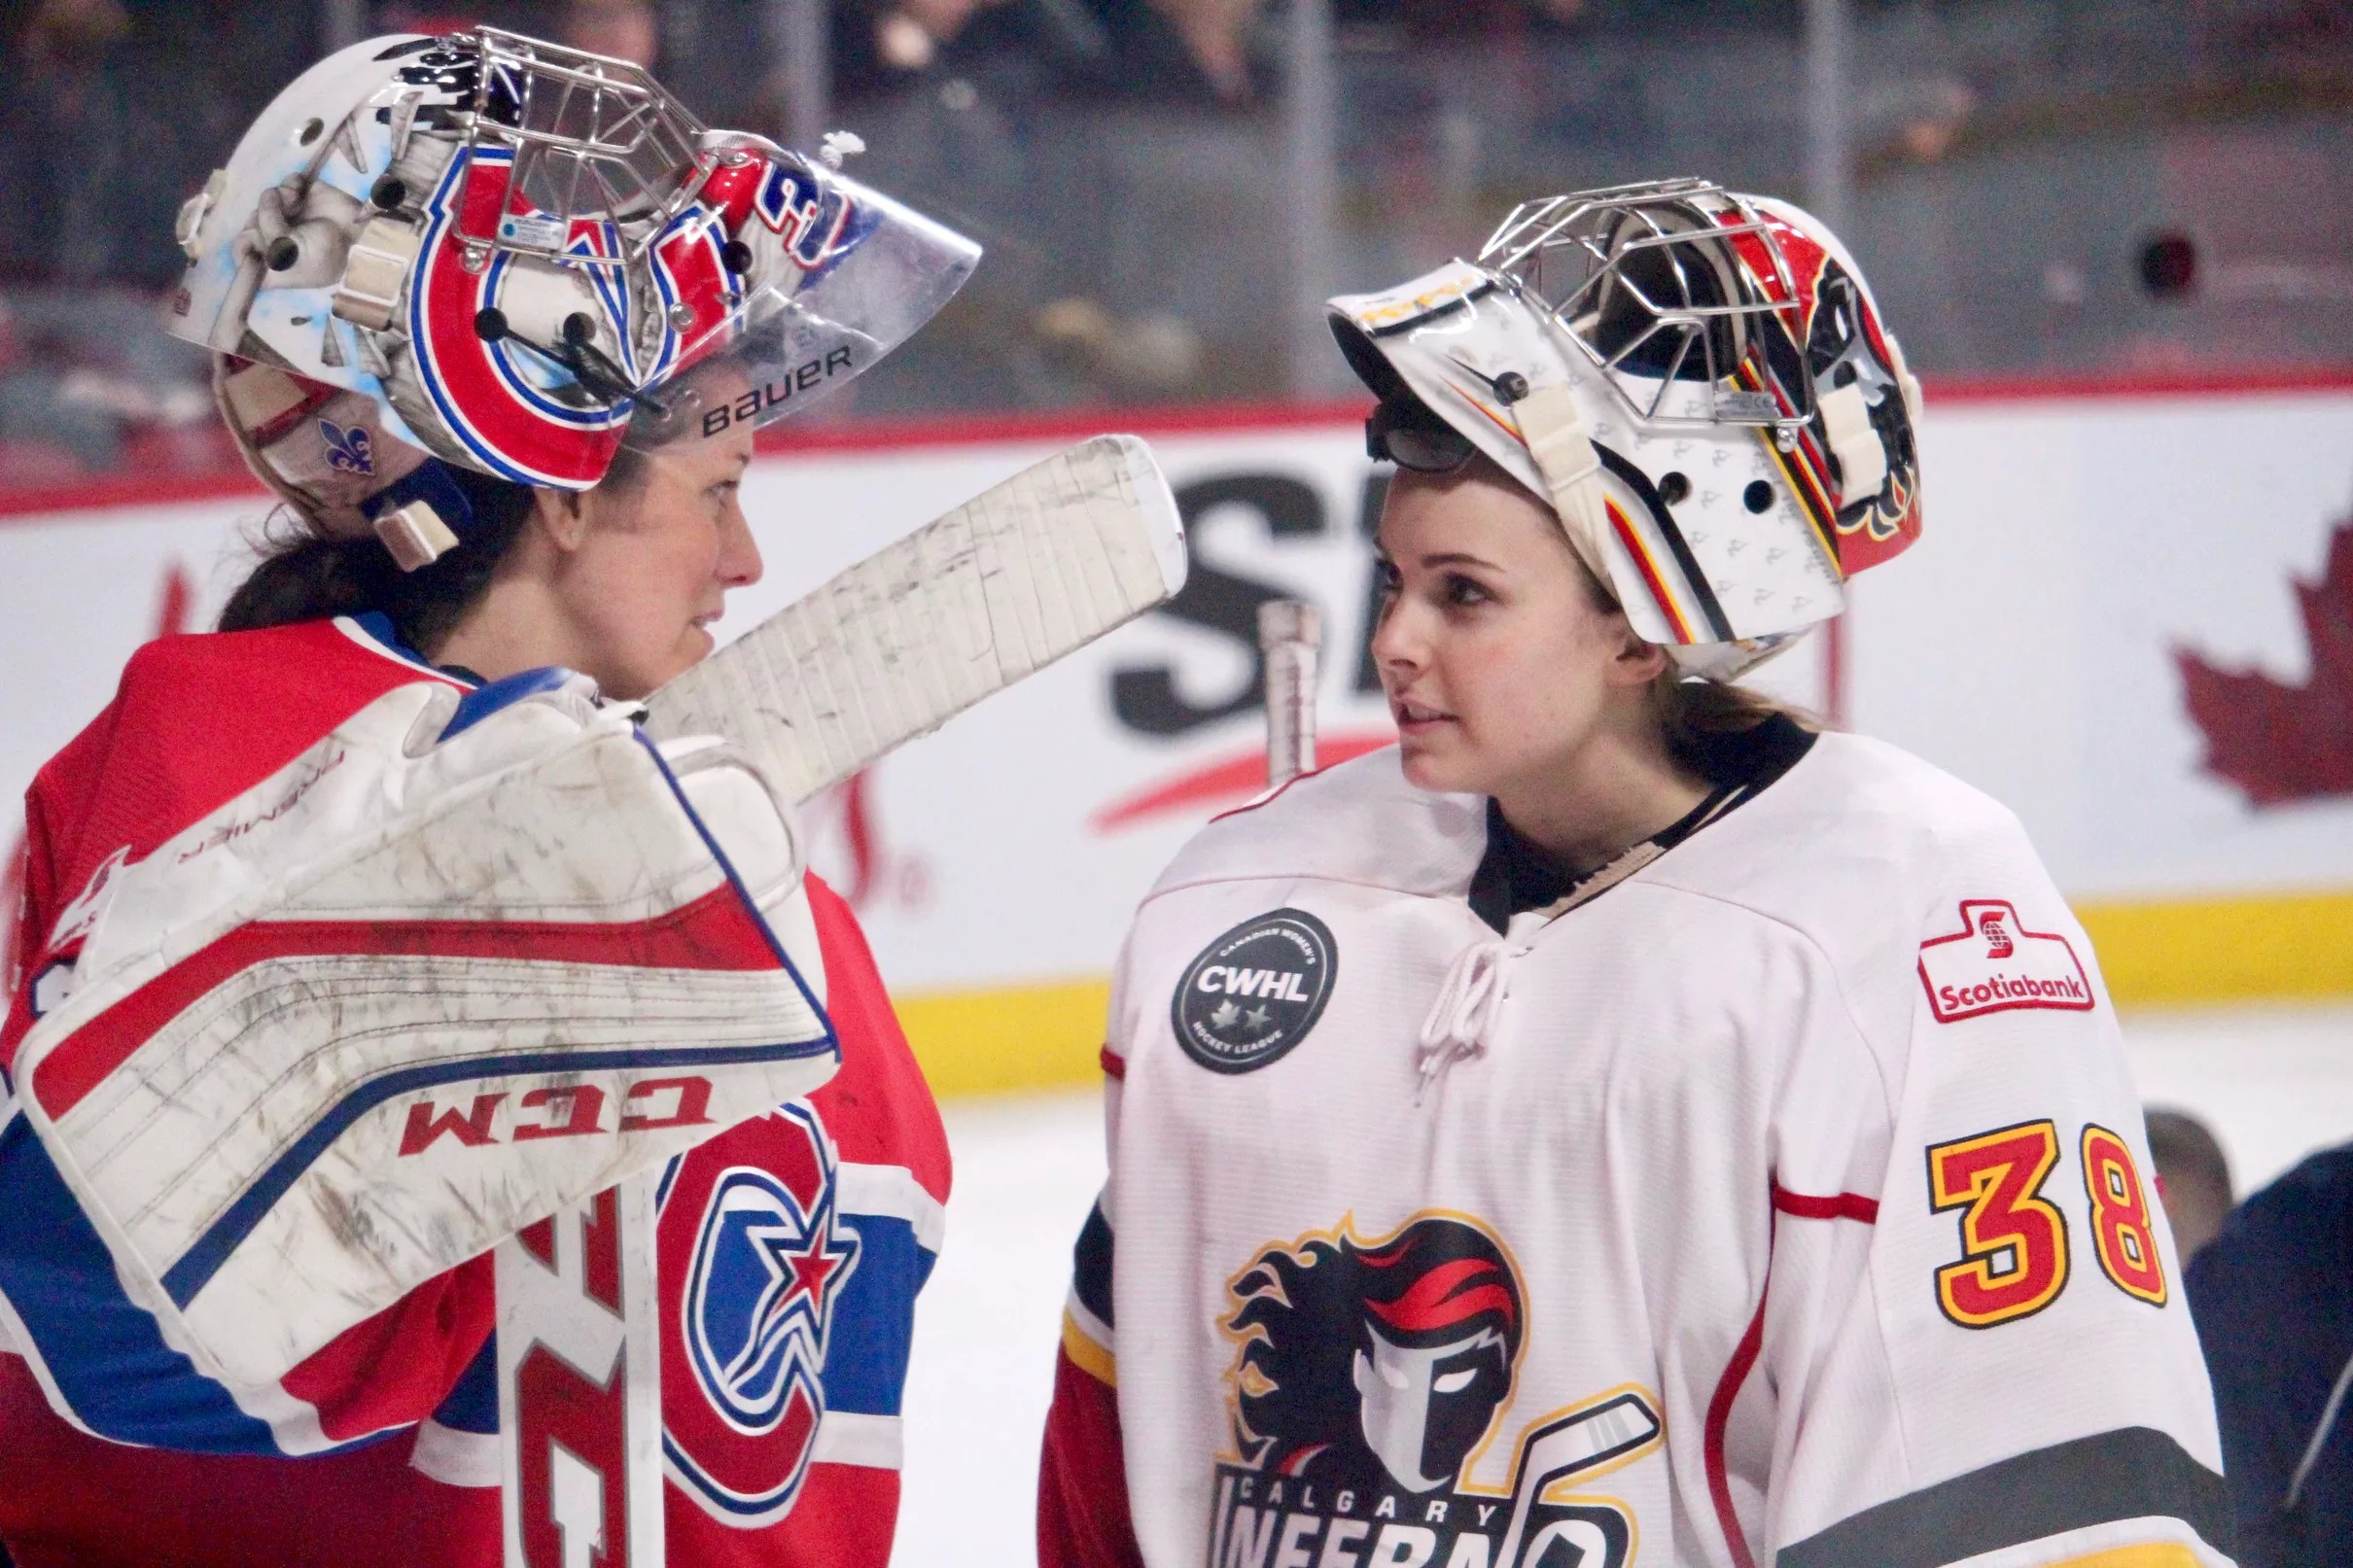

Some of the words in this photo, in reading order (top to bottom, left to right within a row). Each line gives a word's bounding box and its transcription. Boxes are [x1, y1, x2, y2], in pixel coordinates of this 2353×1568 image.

[1219, 927, 1281, 957] CANADIAN
[1281, 927, 1316, 965] WOMEN'S
[1197, 965, 1309, 1002] CWHL
[1940, 973, 2085, 1010] Scotiabank
[1193, 1021, 1233, 1053] HOCKEY
[1234, 1028, 1283, 1054] LEAGUE
[398, 1075, 718, 1158] CCM
[1926, 1118, 2168, 1329] 38
[1240, 1476, 1498, 1527] CALGARY
